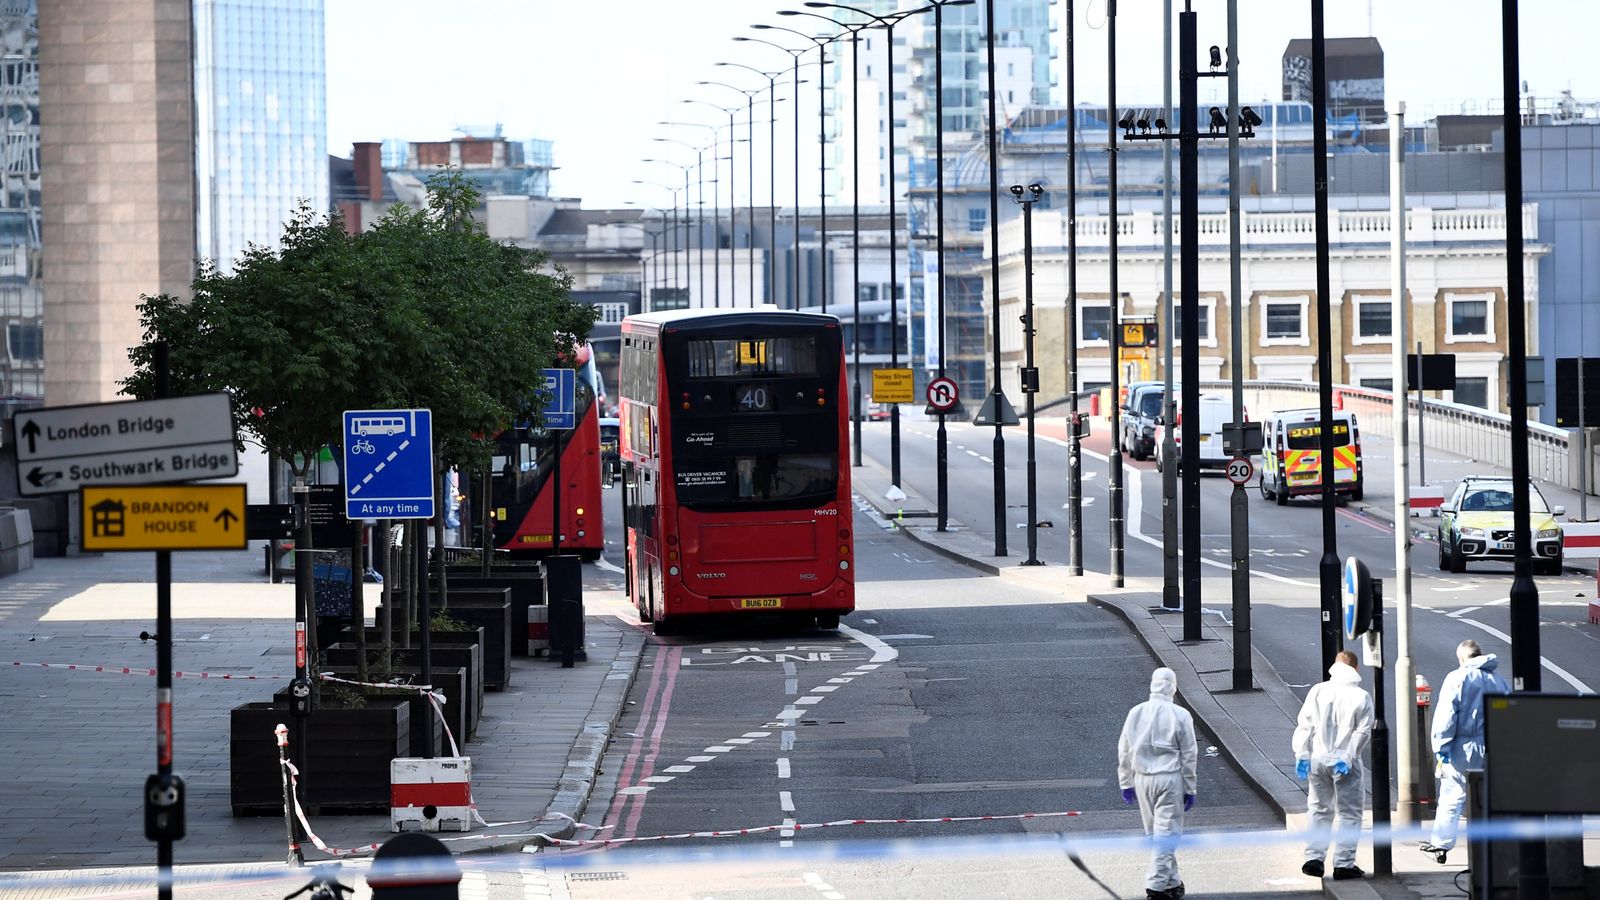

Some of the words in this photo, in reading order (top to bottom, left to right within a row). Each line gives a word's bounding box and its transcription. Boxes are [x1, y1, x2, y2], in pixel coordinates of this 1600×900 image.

[741, 388, 766, 408] 40
[47, 421, 111, 441] London
[117, 416, 175, 434] Bridge
[1288, 424, 1348, 437] POLE
[69, 457, 165, 481] Southwark
[171, 453, 230, 472] Bridge
[1230, 465, 1249, 477] 20
[131, 501, 210, 514] BRANDON
[361, 504, 374, 513] At
[376, 504, 394, 515] any
[396, 503, 420, 513] time
[143, 520, 197, 533] HOUSE
[746, 599, 762, 607] BU16
[763, 599, 777, 607] OZB
[680, 653, 866, 666] LANE
